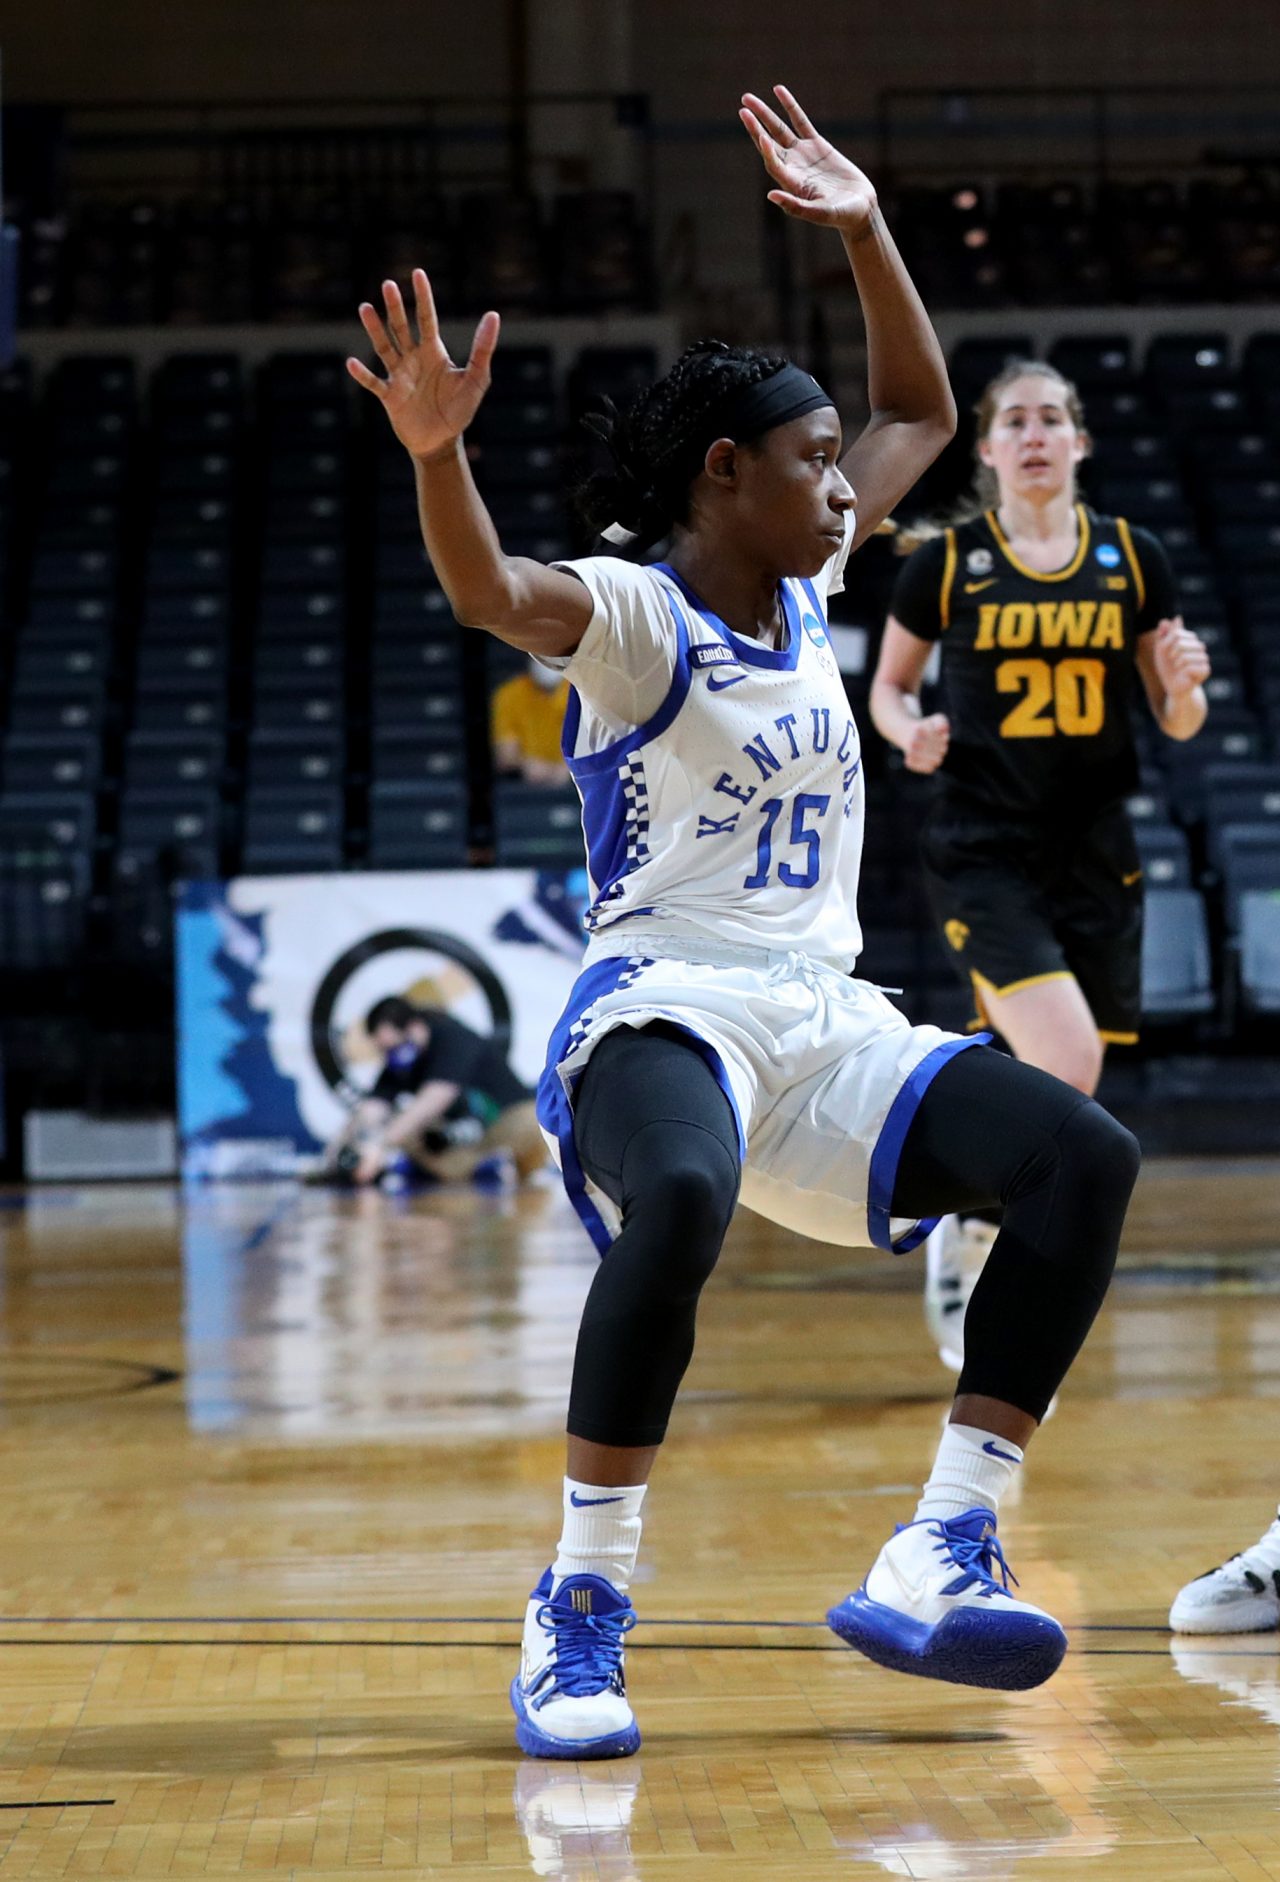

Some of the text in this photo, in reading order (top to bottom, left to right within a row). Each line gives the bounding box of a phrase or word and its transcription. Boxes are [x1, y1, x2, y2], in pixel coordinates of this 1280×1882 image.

[974, 602, 1124, 650] IOWA
[995, 657, 1107, 739] 20
[743, 793, 831, 889] 15
